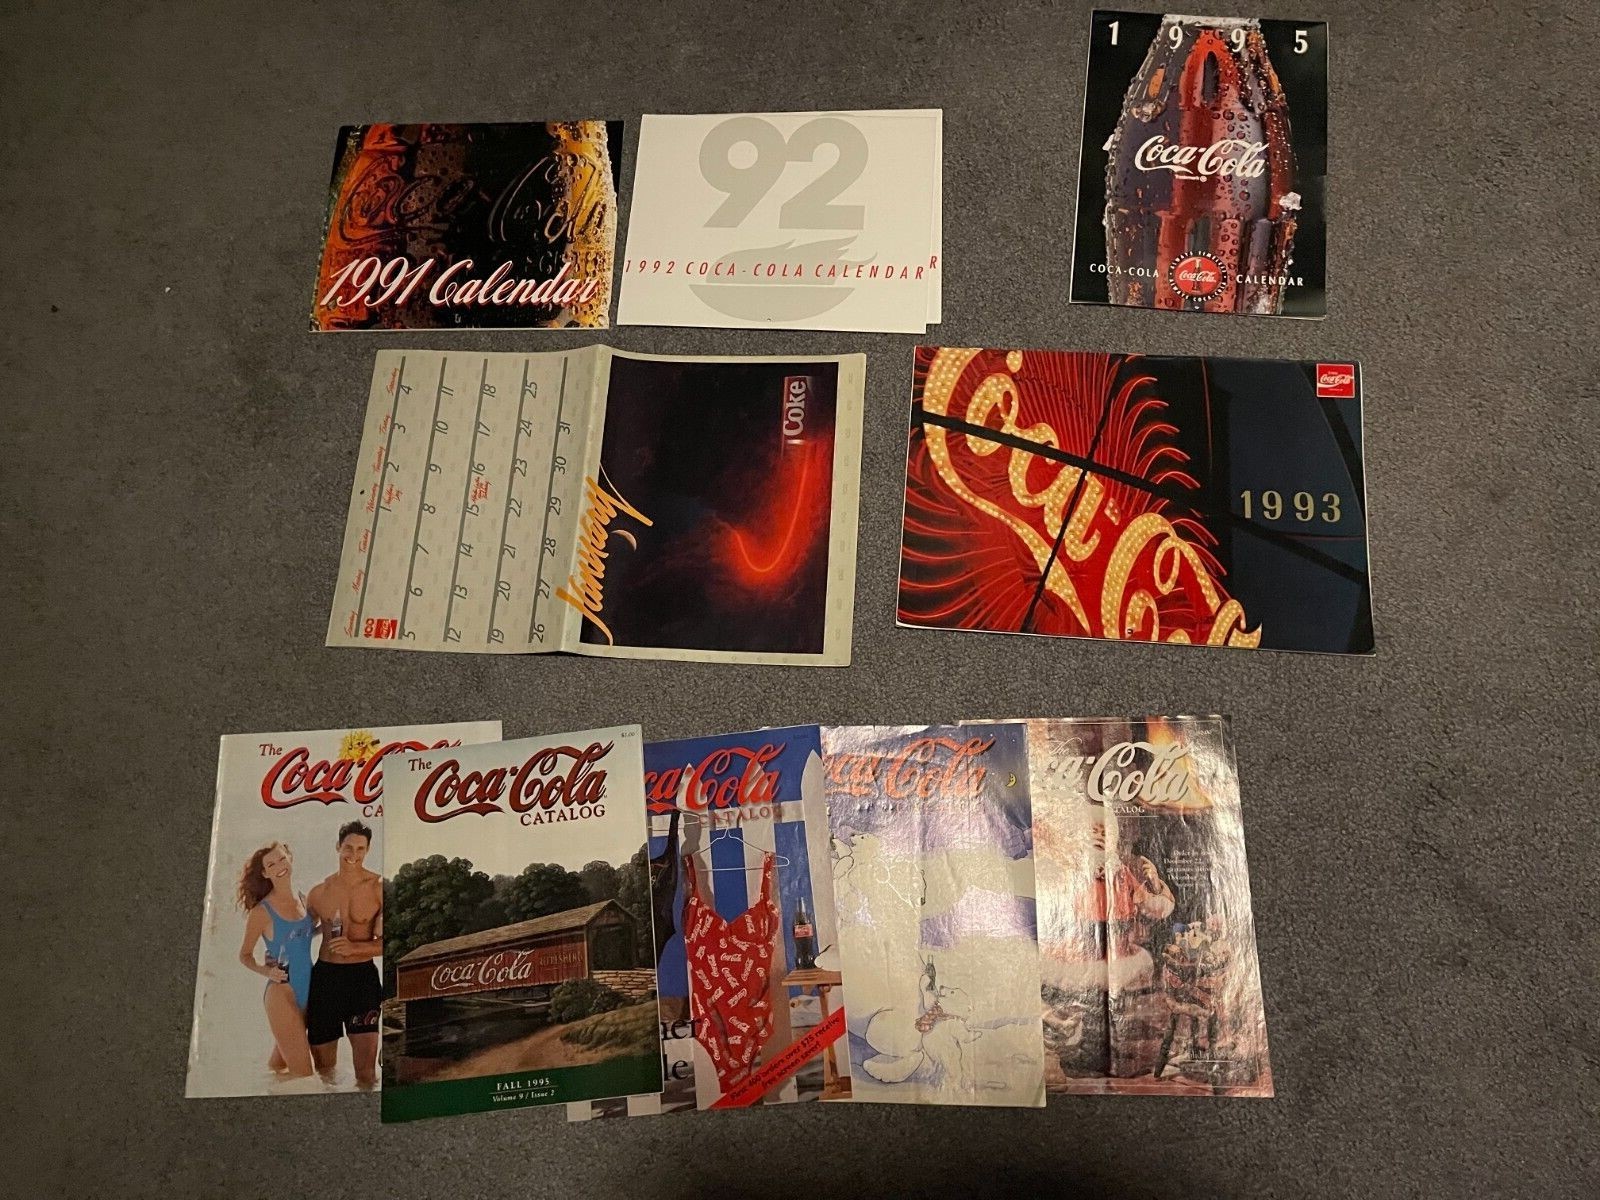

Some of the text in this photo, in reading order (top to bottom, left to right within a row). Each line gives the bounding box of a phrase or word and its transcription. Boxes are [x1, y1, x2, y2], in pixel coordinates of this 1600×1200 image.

[1134, 135, 1269, 178] Coca-Cola
[699, 117, 869, 230] 92
[625, 259, 924, 279] 1992 COCA-COLA CALENDAR
[1089, 263, 1160, 278] COCA-COLA
[320, 256, 599, 308] 1991 Calendar
[1236, 274, 1304, 287] CALENDAR
[482, 384, 496, 398] 18
[783, 381, 807, 436] Coke
[387, 461, 399, 472] 2
[393, 423, 406, 434] 3
[400, 384, 413, 395] 4
[477, 421, 490, 437] 17
[472, 463, 485, 476] 16
[403, 386, 454, 640] 5 6 7 8 9 10 11
[466, 504, 479, 516] 15
[491, 381, 537, 644] 19 20 21 22 23 24 25
[1240, 490, 1342, 523] 1993
[533, 421, 571, 643] 26 27 28 29 30 31
[460, 543, 473, 557] 14
[556, 477, 653, 646] January
[454, 584, 468, 599] 13
[447, 627, 461, 643] 12
[259, 744, 282, 756] The
[261, 739, 460, 809] Coca-C
[408, 758, 432, 771] The
[414, 741, 614, 823] Coca-Cola
[520, 804, 606, 826] CATALOG
[431, 948, 537, 990] Coca-Cola
[497, 1078, 550, 1091] FALL 1995
[531, 1091, 548, 1099] Issue
